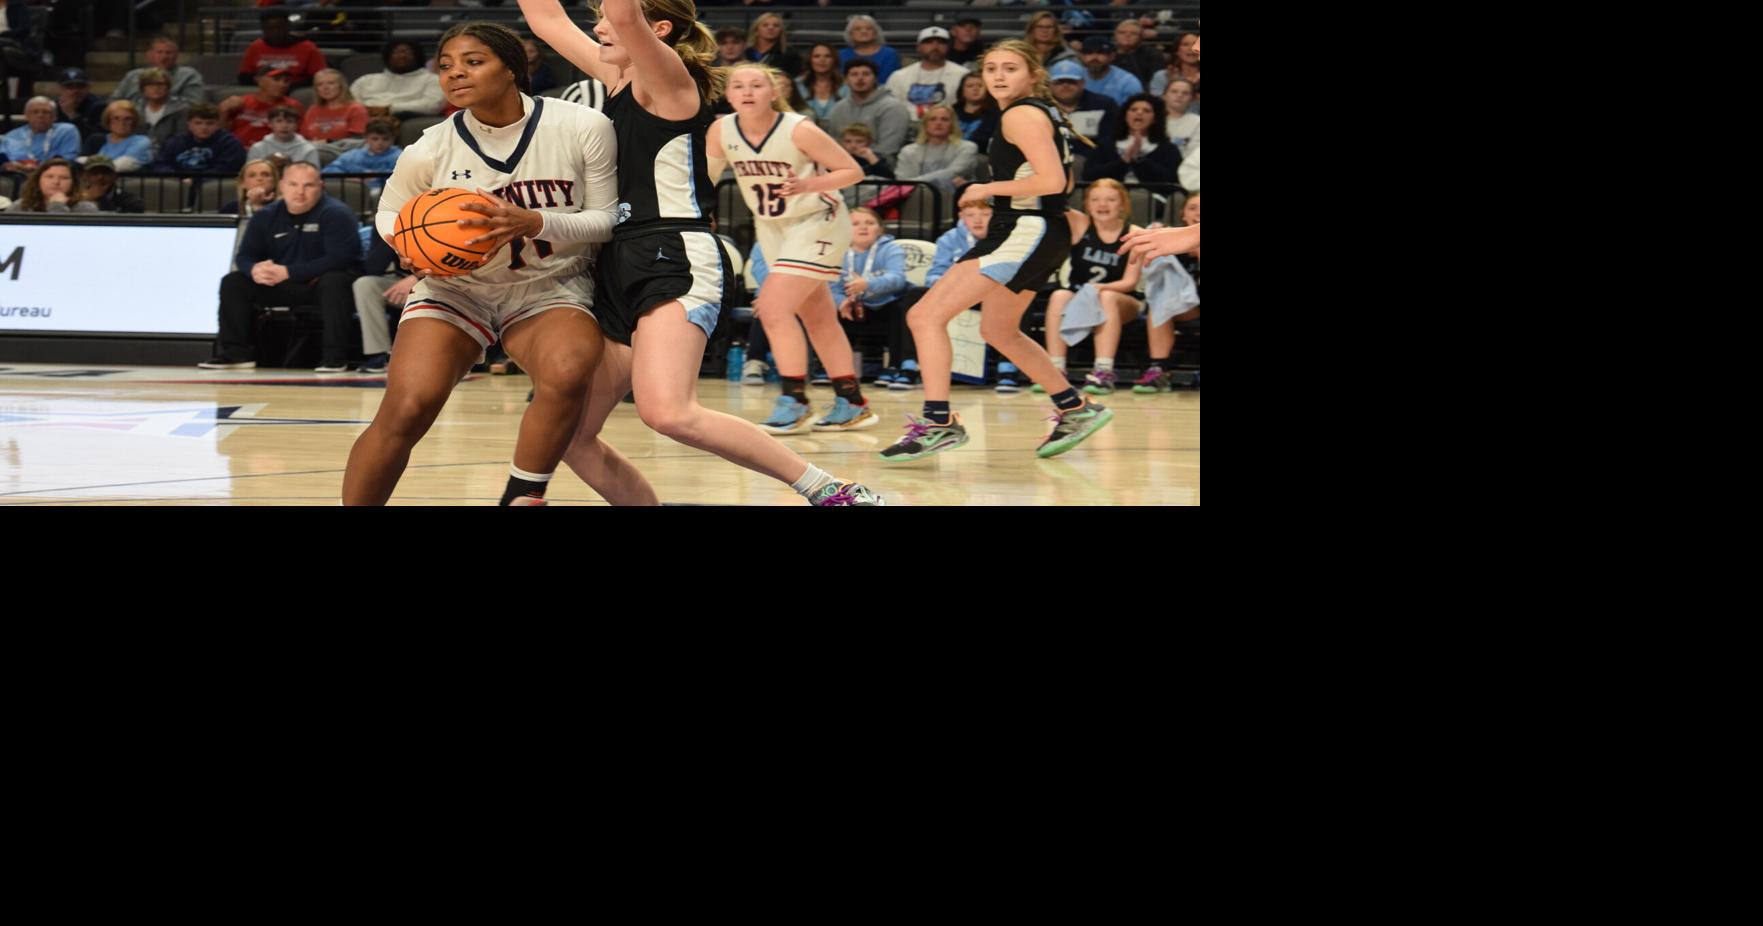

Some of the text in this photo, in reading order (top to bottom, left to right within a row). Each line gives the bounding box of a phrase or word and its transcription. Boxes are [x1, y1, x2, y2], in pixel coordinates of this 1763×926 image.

[751, 183, 786, 217] 15
[816, 240, 832, 255] T
[1082, 246, 1120, 266] LADY
[1088, 265, 1108, 284] 2
